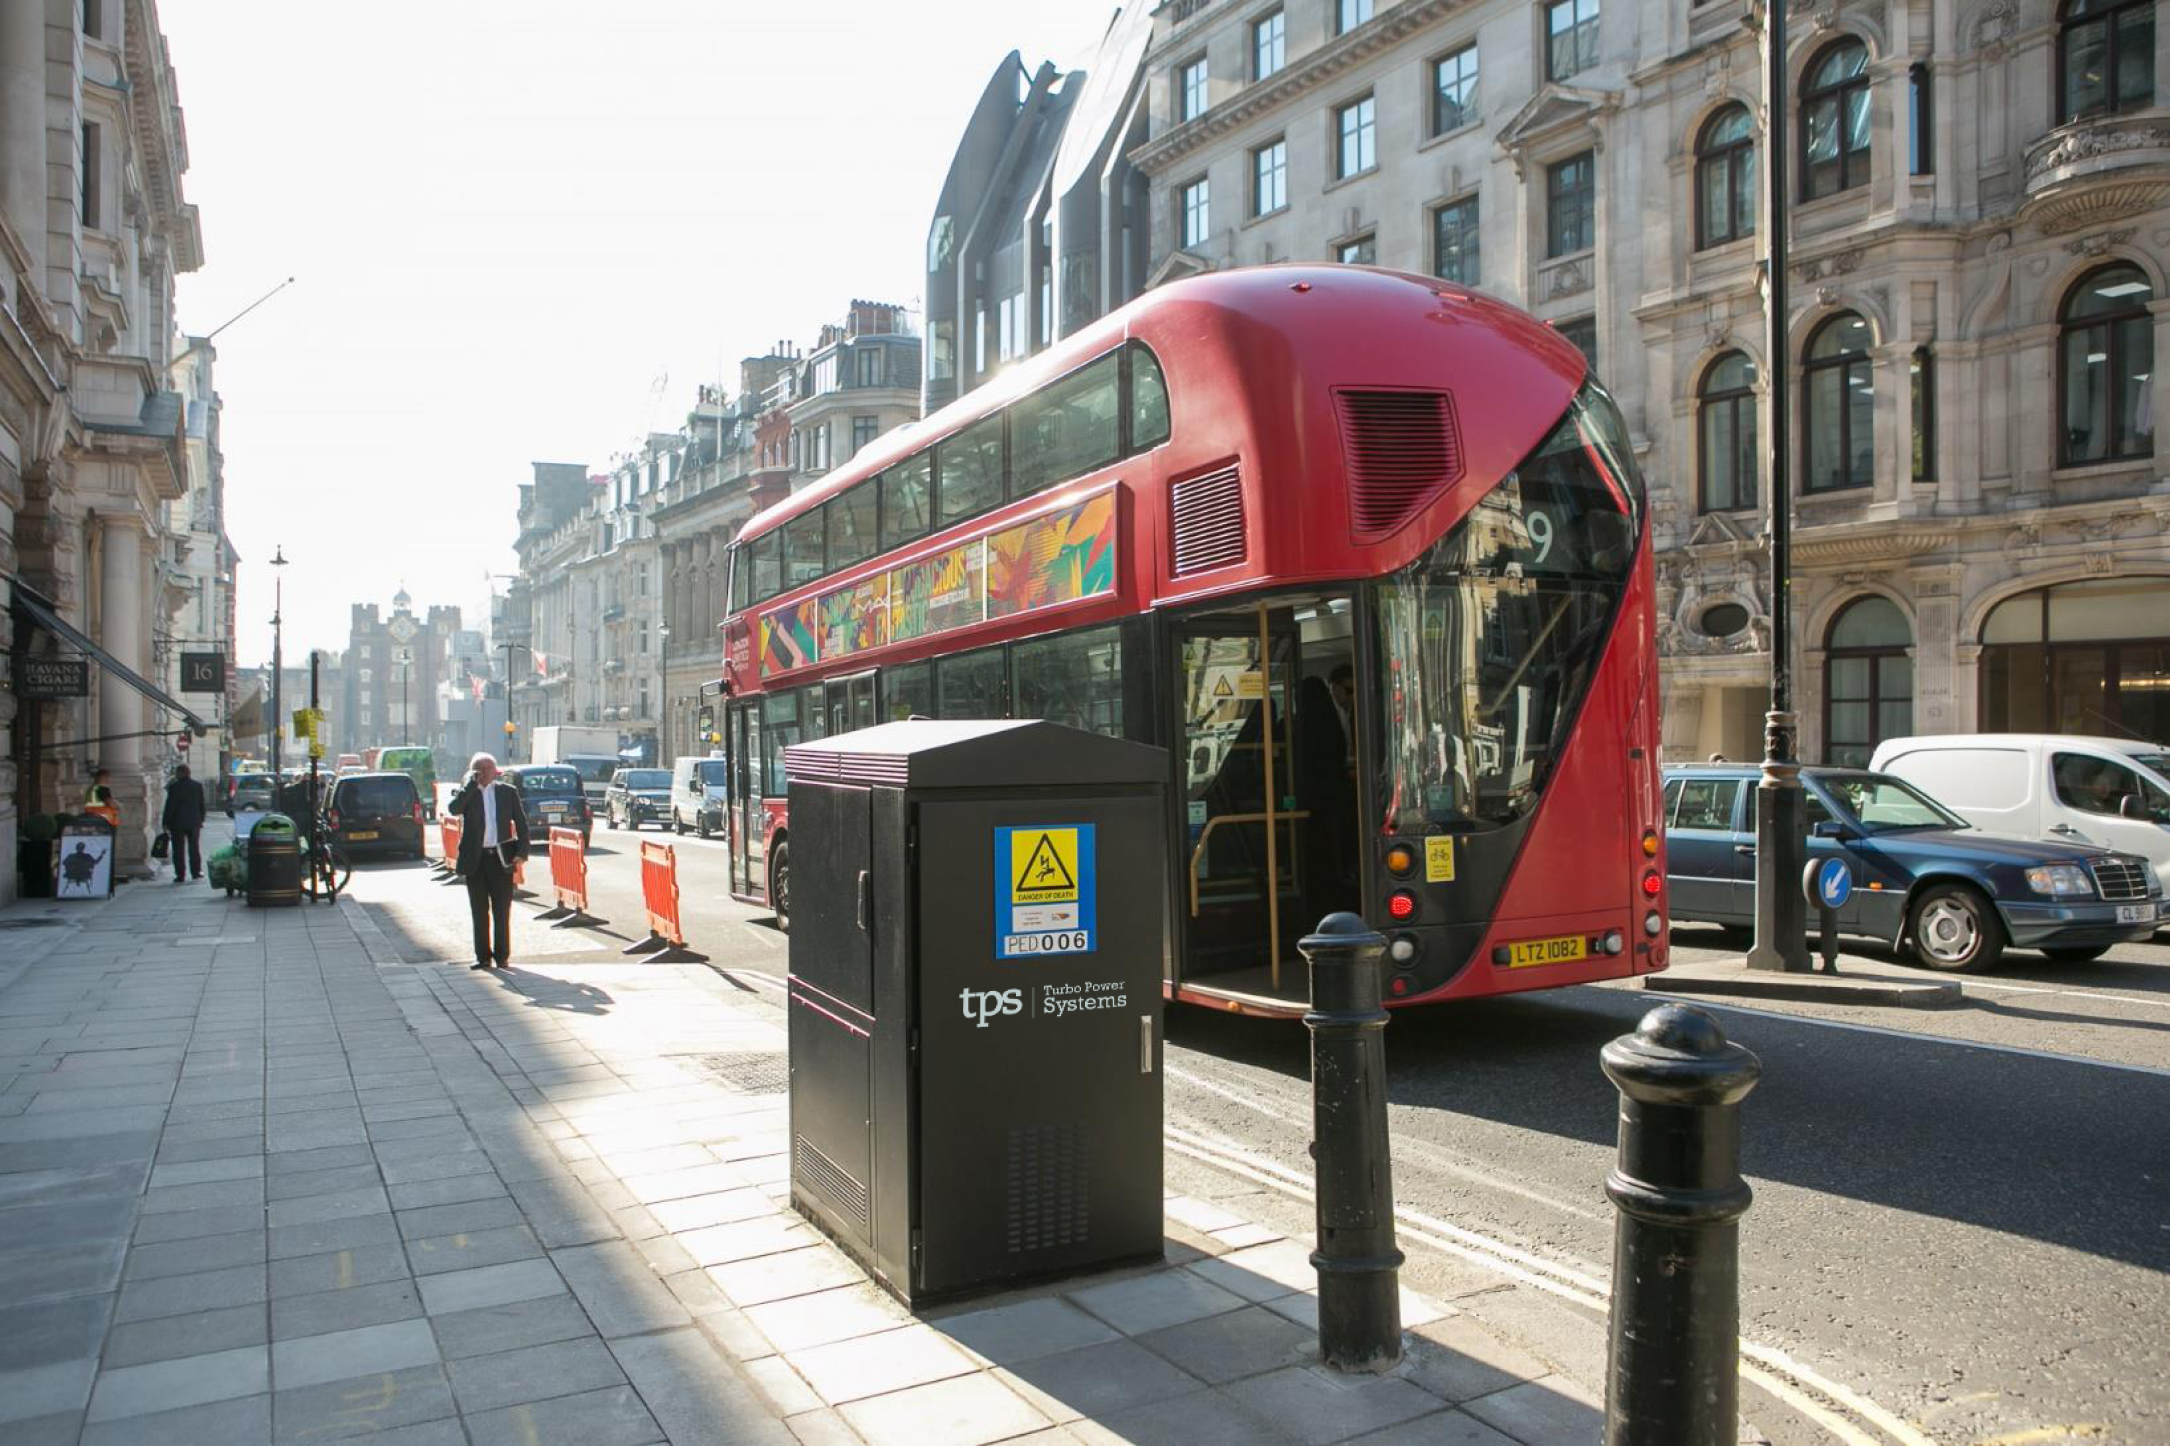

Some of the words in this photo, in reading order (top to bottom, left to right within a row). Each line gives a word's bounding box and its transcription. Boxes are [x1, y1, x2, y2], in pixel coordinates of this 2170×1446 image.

[1527, 511, 1552, 563] 9
[24, 662, 82, 675] HAVANA
[192, 662, 213, 680] 16
[26, 674, 80, 685] CIGARS
[1018, 893, 1043, 901] DANGER
[1053, 891, 1074, 899] DEATH
[1516, 943, 1545, 963] LTZ
[1548, 939, 1578, 959] 1082
[1043, 984, 1082, 996] Turbo
[1085, 981, 1126, 993] Power
[959, 987, 1023, 1028] tps
[1043, 994, 1127, 1018] Systems
